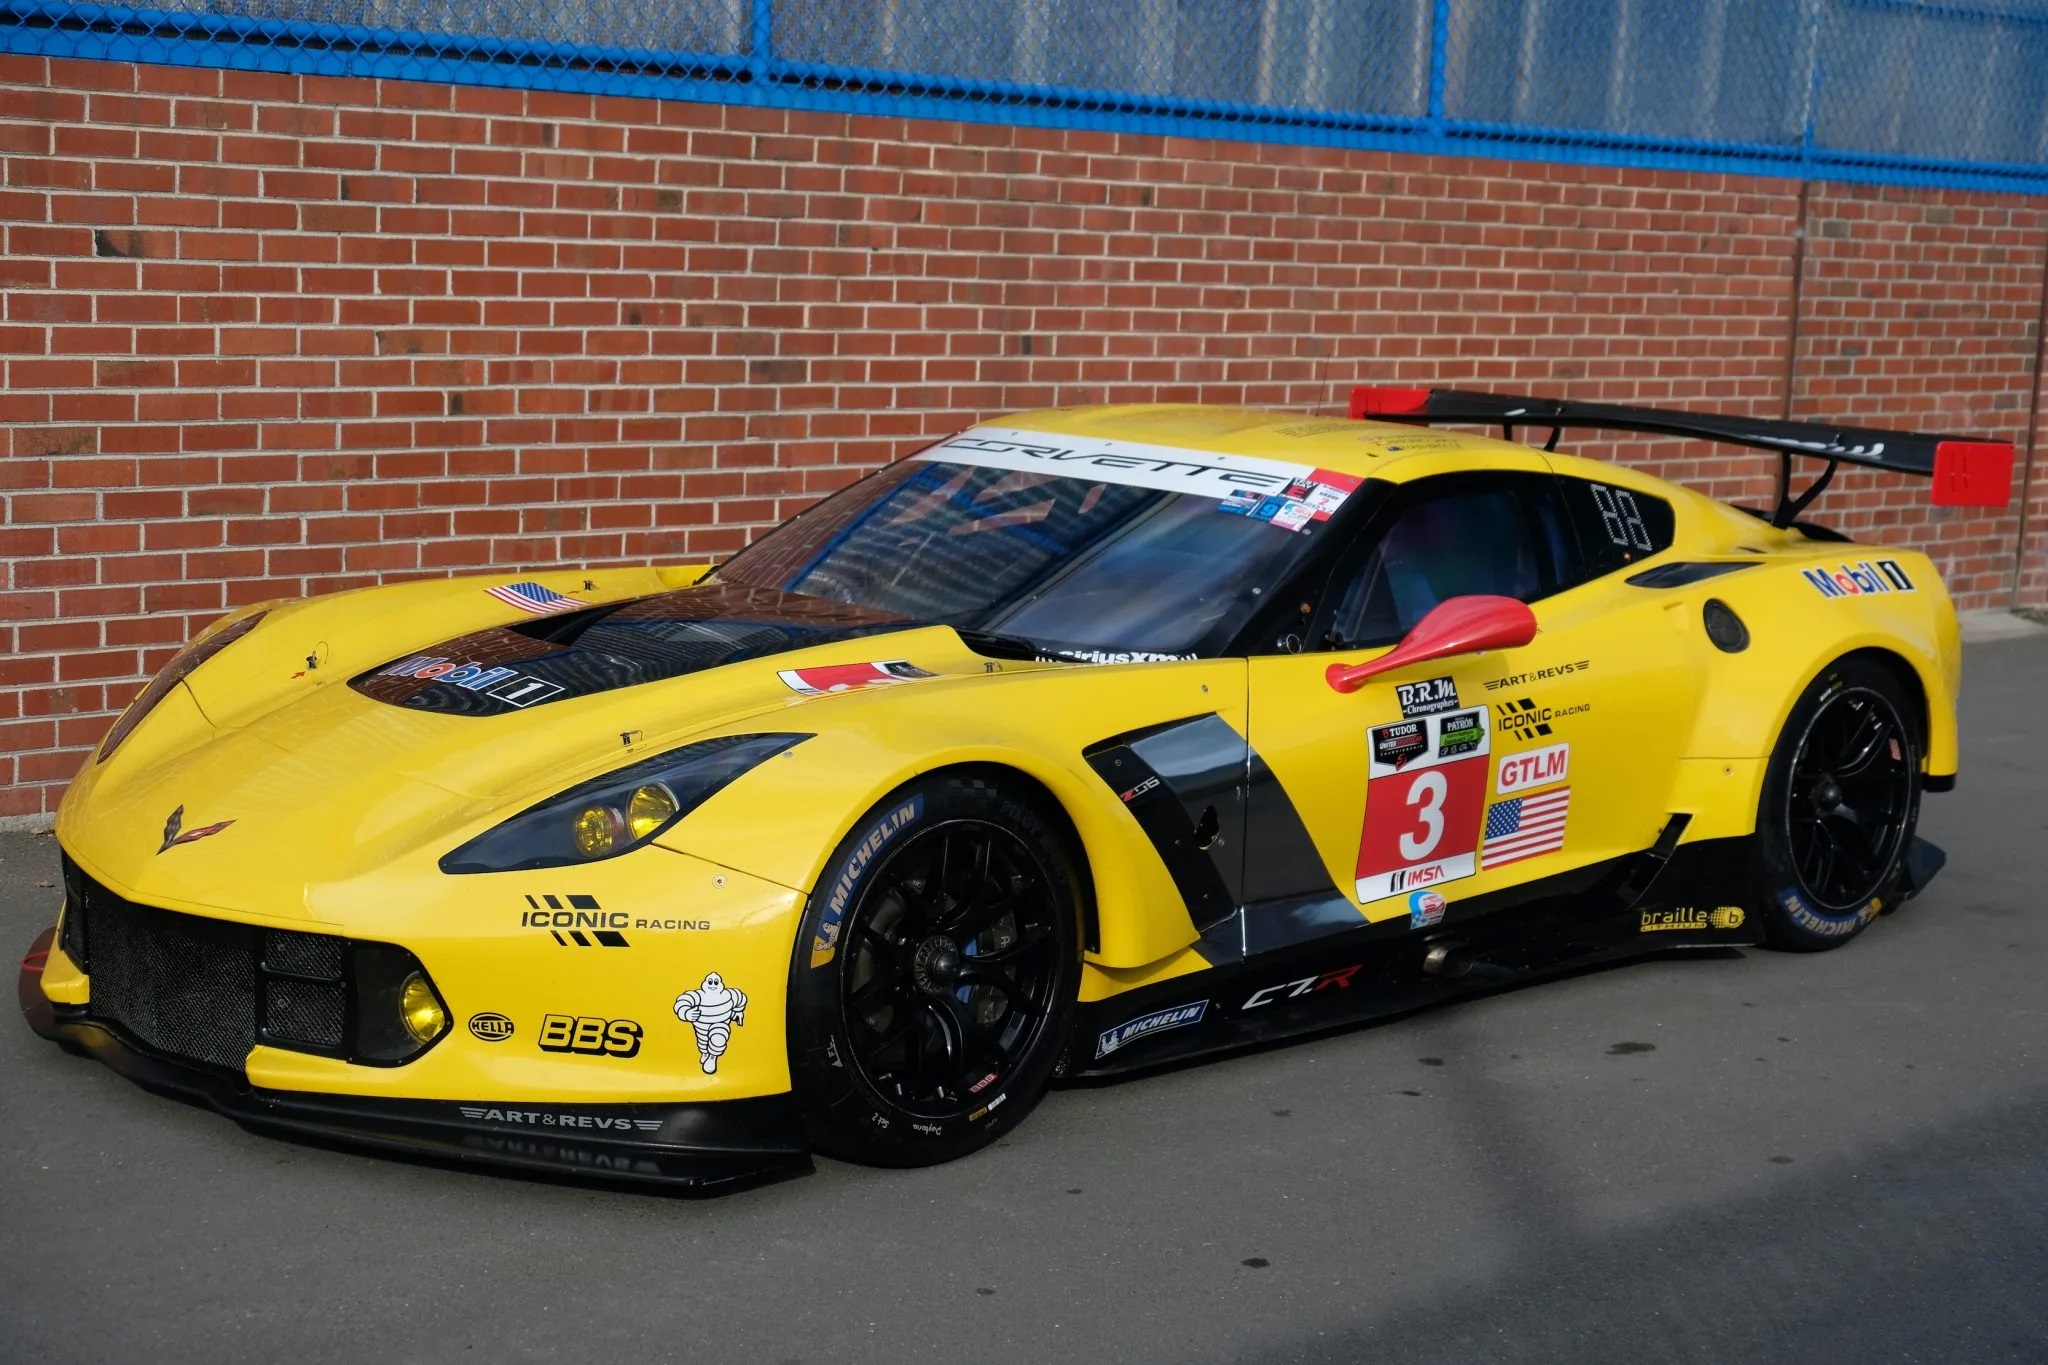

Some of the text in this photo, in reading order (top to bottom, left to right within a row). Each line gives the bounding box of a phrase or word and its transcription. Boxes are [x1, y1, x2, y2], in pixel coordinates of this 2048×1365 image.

[942, 438, 1291, 487] CORVETTE
[1801, 562, 1890, 599] Mobil
[377, 657, 519, 691] Mobil
[1390, 724, 1417, 737] TUDOR
[1498, 704, 1590, 732] ICONIC RACING
[1501, 750, 1566, 787] GTLM
[1398, 771, 1448, 861] 3
[830, 803, 915, 915] MICHELIN
[1407, 865, 1444, 886] IMSA
[521, 911, 711, 930] ICONIC RACING
[1641, 907, 1708, 925] braille
[470, 1018, 515, 1034] HELLA
[538, 1014, 644, 1058] BBS
[1122, 1006, 1201, 1040] MICHELIN
[483, 1108, 631, 1130] ART&REVS
[913, 1123, 942, 1135] Daytona
